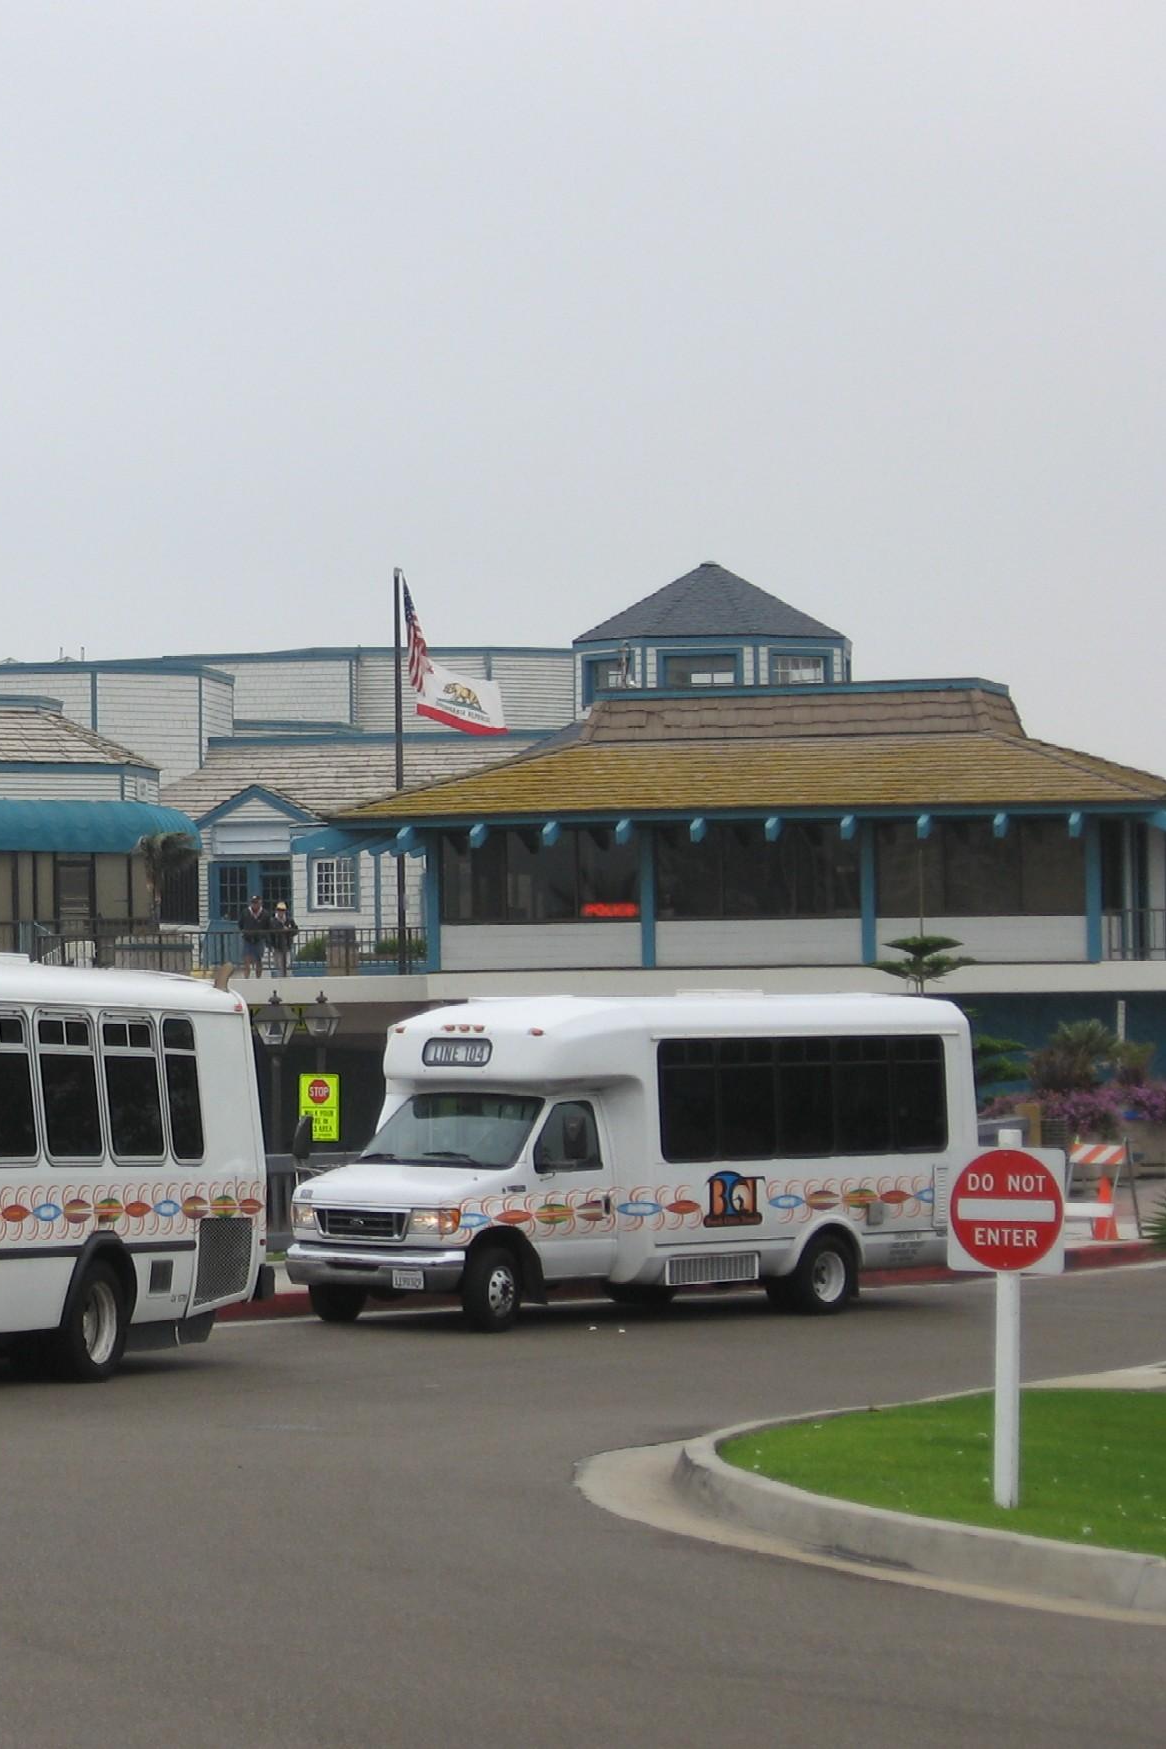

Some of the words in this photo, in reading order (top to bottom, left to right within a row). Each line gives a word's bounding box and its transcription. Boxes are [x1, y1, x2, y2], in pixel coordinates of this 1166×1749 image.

[434, 1046, 459, 1062] LINE
[465, 1046, 485, 1063] 104
[309, 1086, 330, 1097] STOP
[967, 1174, 994, 1191] DO
[1007, 1175, 1046, 1193] NOT
[974, 1227, 1038, 1248] ENTER
